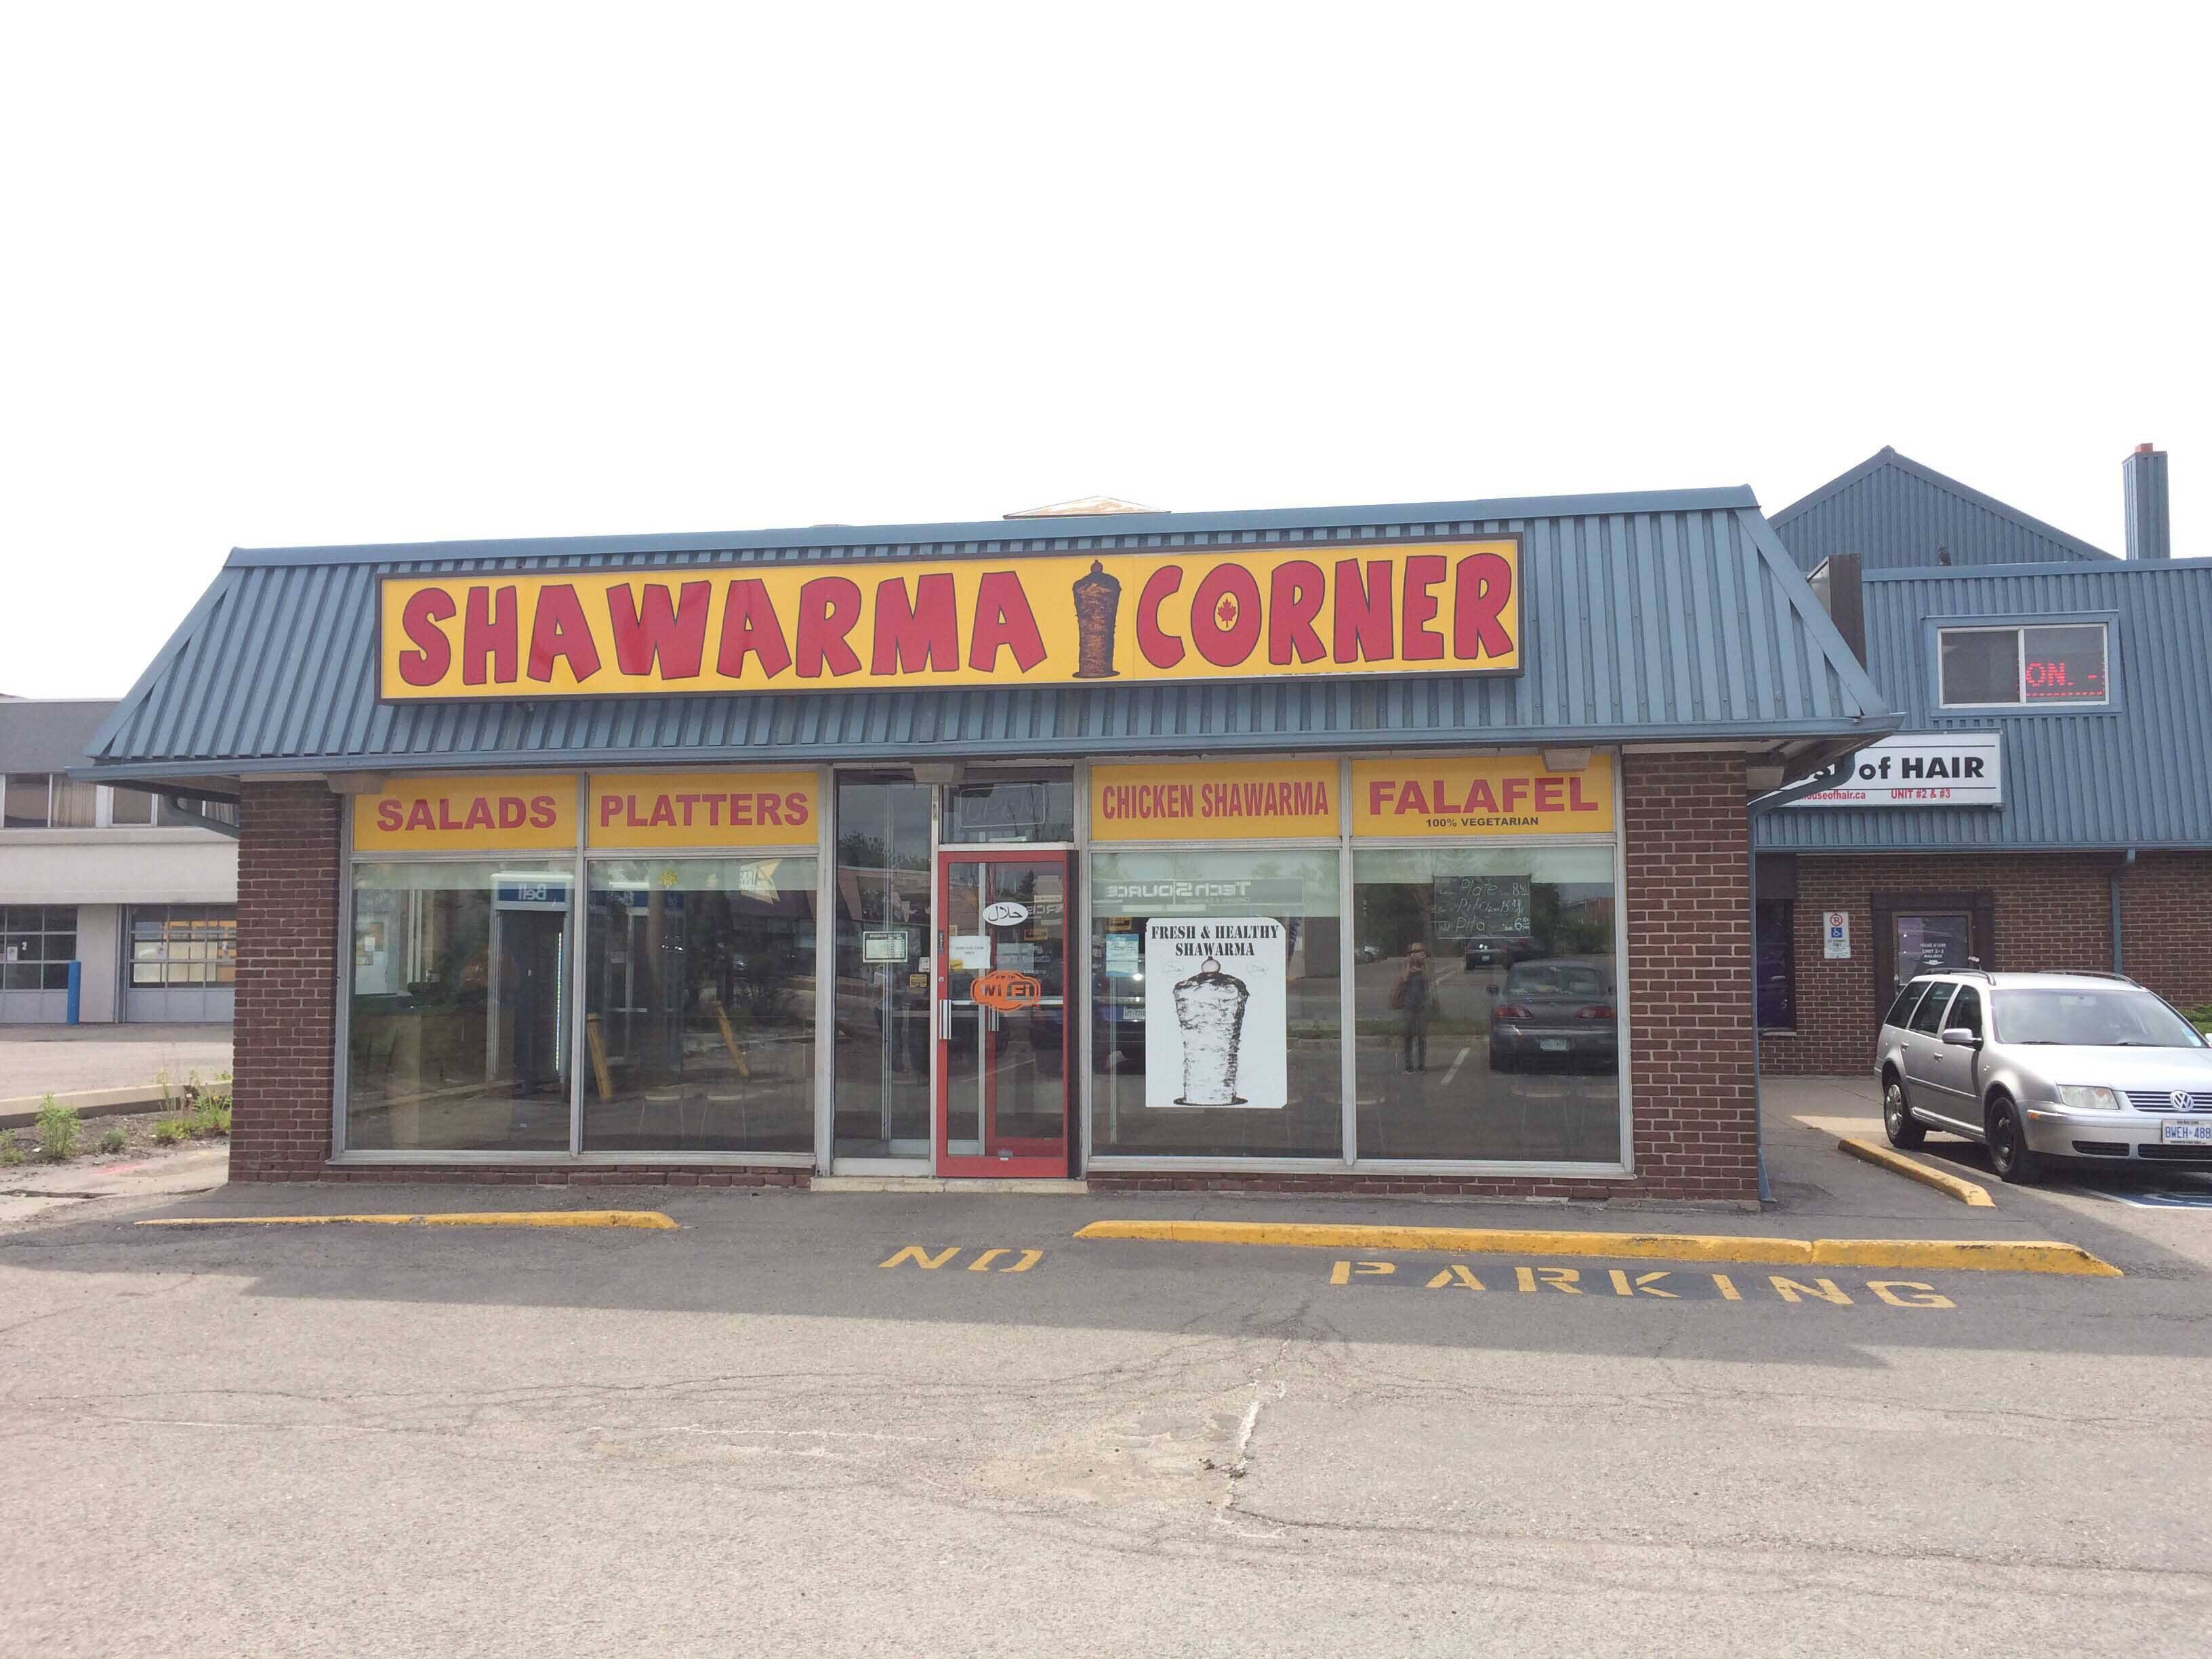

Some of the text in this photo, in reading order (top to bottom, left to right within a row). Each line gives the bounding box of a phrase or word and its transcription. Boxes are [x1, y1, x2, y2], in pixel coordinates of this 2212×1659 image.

[399, 552, 1513, 687] SHAWARMA CORNER
[1858, 756, 1891, 779] of
[1901, 756, 1984, 779] HAIR
[1102, 781, 1330, 819] CHICKEN SHAWARMA
[1369, 777, 1599, 815] FALAFEL
[1891, 788, 1913, 799] UNIT
[1916, 788, 1927, 798] #2
[1930, 787, 1936, 798] &
[1940, 787, 1950, 798] #3
[376, 796, 556, 832] SALADS
[600, 792, 809, 827] PLATTERS
[1426, 816, 1539, 827] 100% VEGETARIAN
[988, 905, 1023, 921] حلال
[1151, 925, 1279, 939] FRESH & HEALTHY
[22, 941, 27, 950] 2
[1175, 942, 1255, 956] SHAWARMA
[2165, 1126, 2188, 1139] BWEH
[878, 1246, 1958, 1309] NO PARKING
